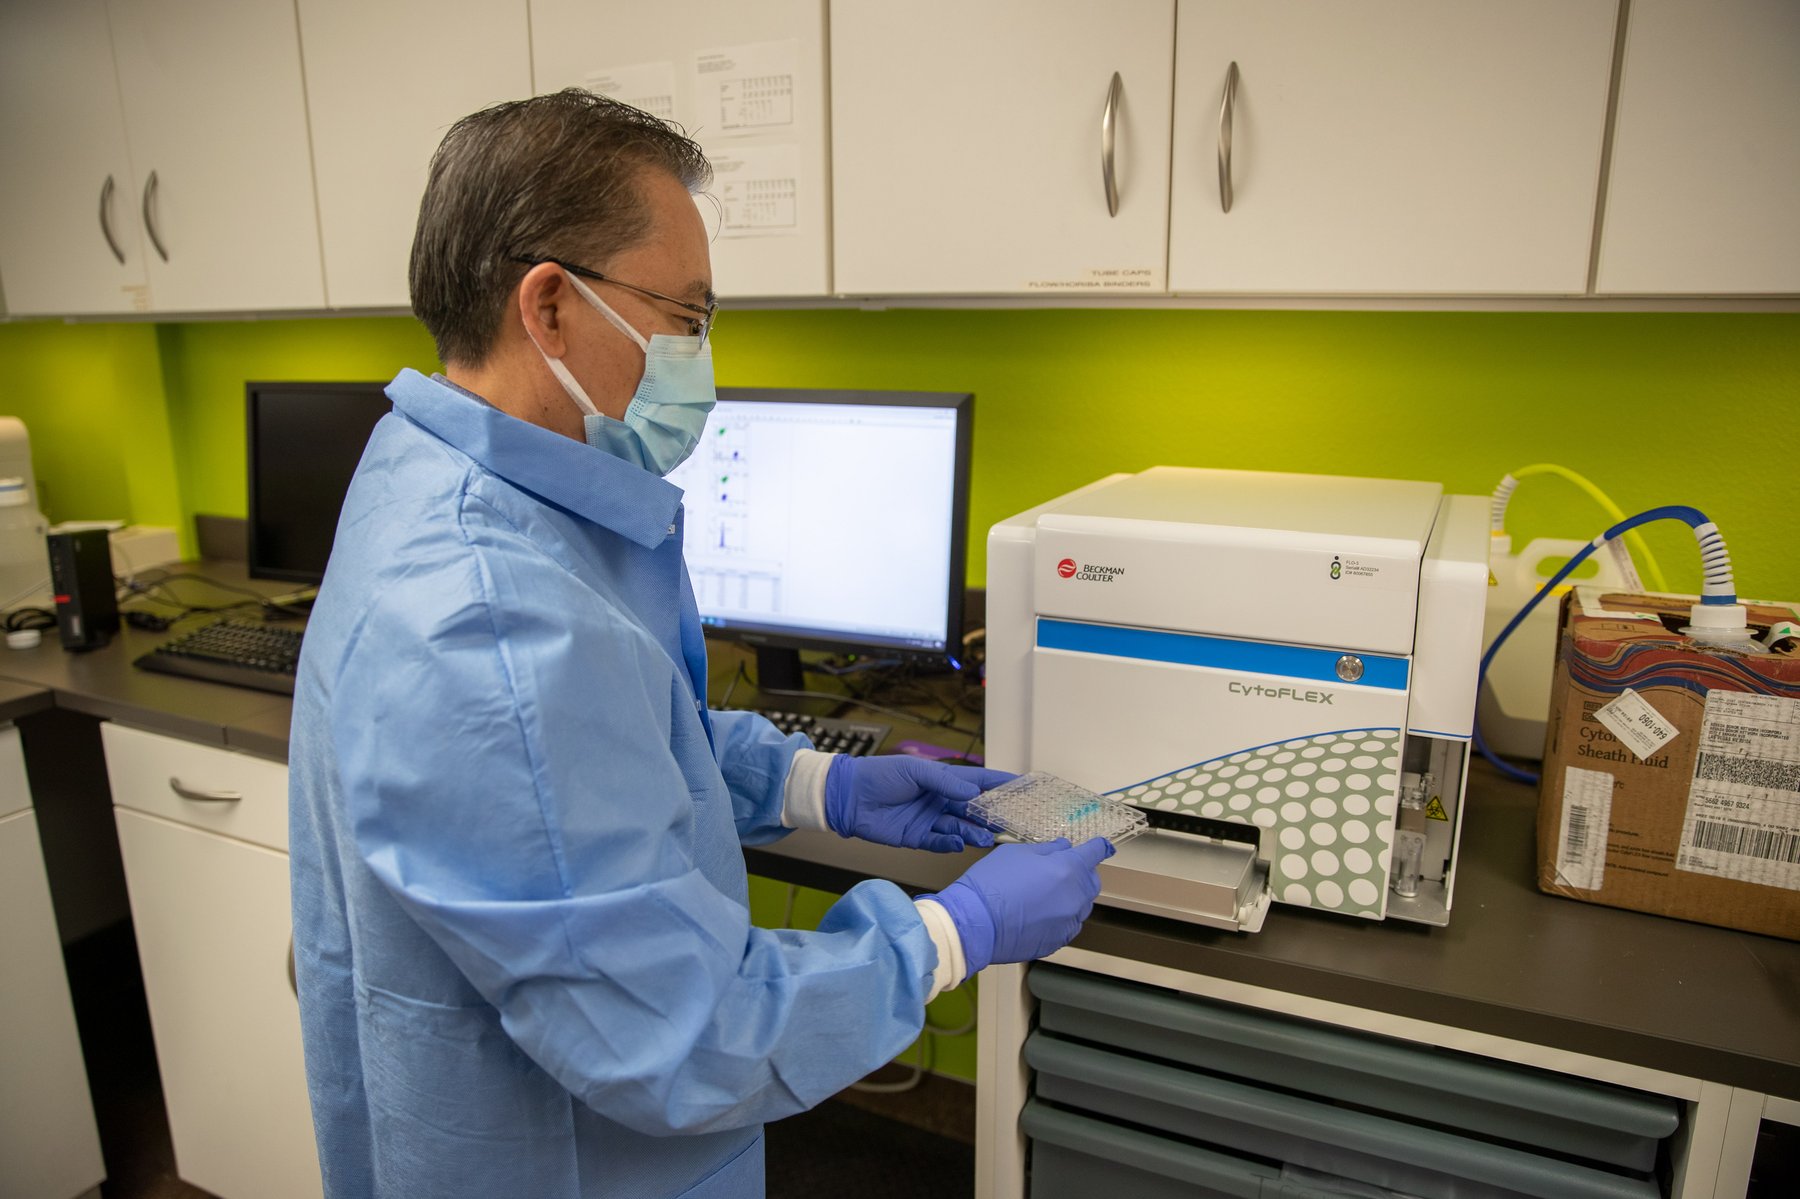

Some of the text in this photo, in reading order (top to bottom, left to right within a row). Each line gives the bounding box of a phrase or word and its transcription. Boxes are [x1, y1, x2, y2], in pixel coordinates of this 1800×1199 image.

[1092, 269, 1152, 277] TUBE CAPS
[1083, 564, 1125, 575] BECKMAN
[1076, 571, 1114, 583] COULTER
[1228, 681, 1334, 705] CytoFLEX
[1577, 744, 1627, 763] Sheath
[1720, 799, 1734, 807] 4967
[1735, 801, 1750, 809] 9324
